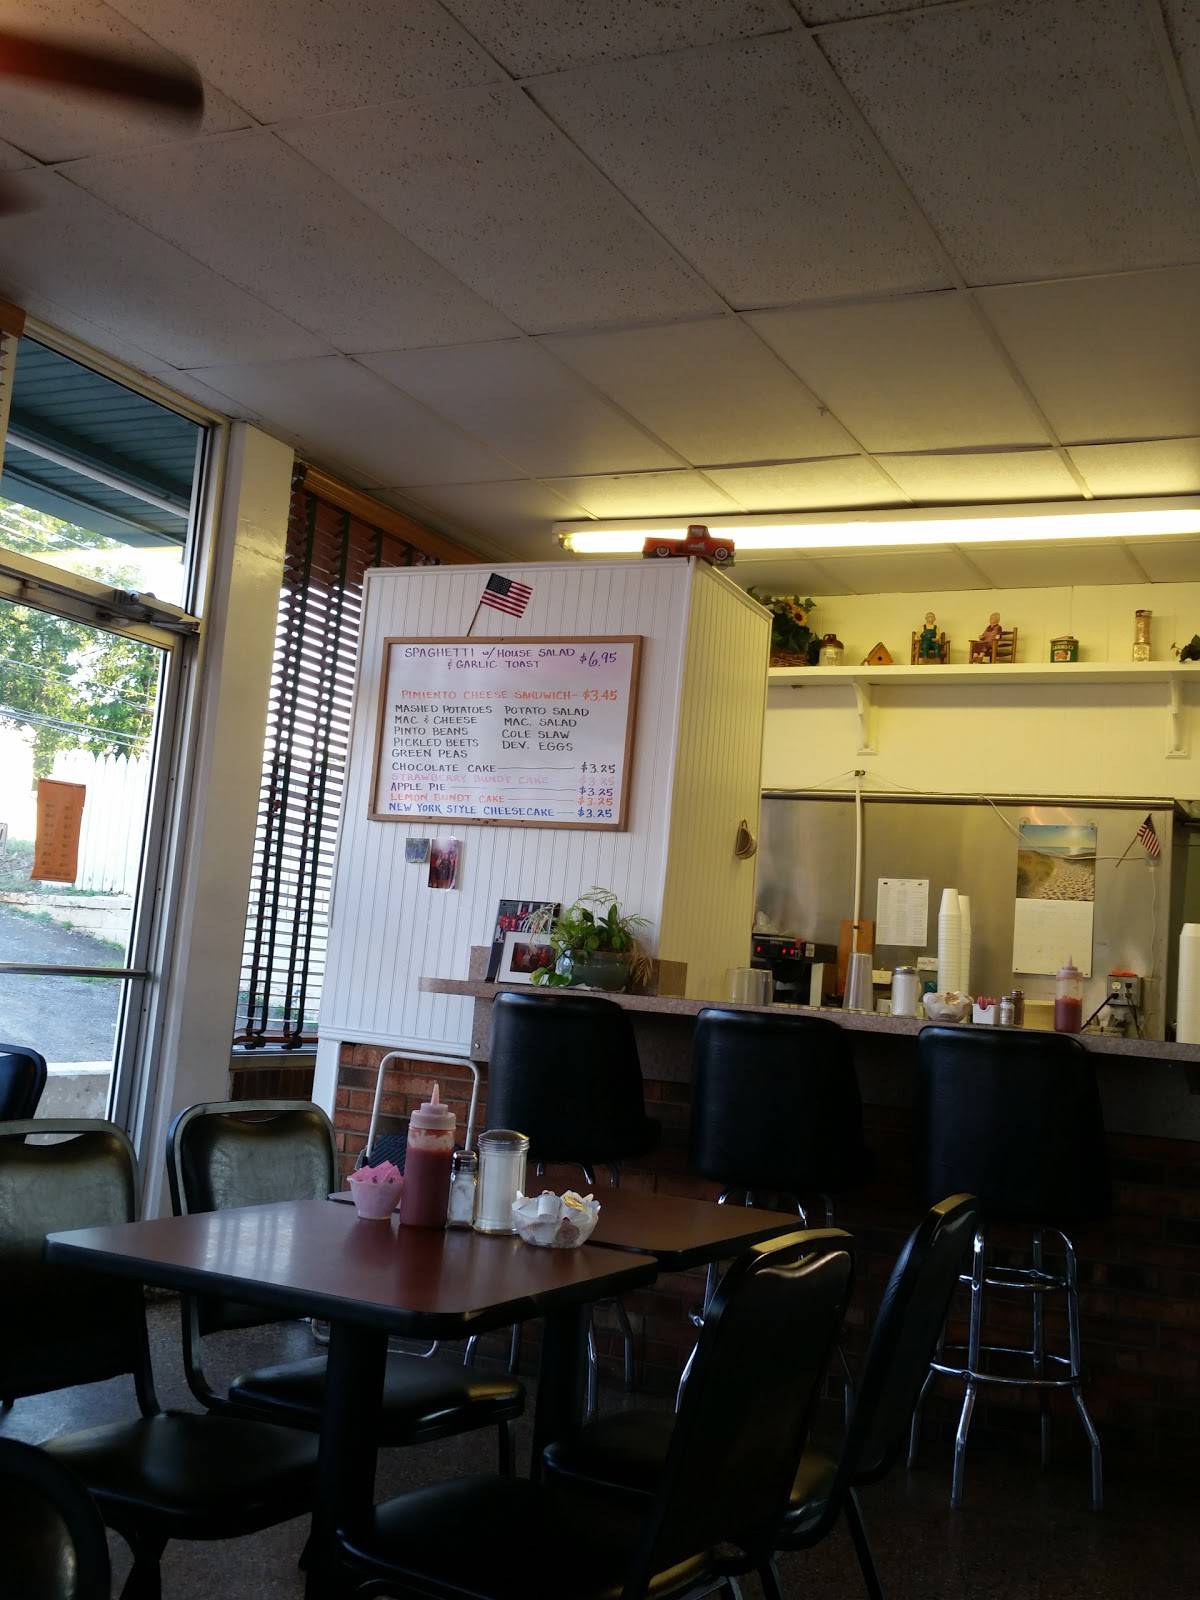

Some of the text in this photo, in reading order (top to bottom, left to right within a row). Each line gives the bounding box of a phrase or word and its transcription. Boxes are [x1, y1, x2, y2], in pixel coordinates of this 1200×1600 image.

[405, 647, 475, 658] SPAGHETTI
[497, 649, 533, 658] HOUSE
[538, 648, 576, 657] SALAD
[579, 651, 617, 667] $6.95
[456, 660, 497, 669] GARLIC
[505, 660, 540, 669] TOAST
[463, 690, 507, 699] CHEESE
[582, 688, 617, 701] $3.45
[395, 704, 493, 714] MASHED POTATOES
[504, 705, 590, 717] POTATO SALAD
[394, 715, 418, 725] MAC
[433, 715, 478, 724] CHEESE
[539, 718, 577, 727] SALAD
[394, 726, 469, 736] PINTO BEANS
[502, 729, 570, 739] COLE SLAW
[393, 737, 479, 747] PICKLED BEETS
[502, 740, 574, 752] DEV. EGGS
[391, 748, 468, 758] GREEN PEAS
[391, 761, 616, 774] CHOCOLATE CAKE $3.25
[519, 776, 550, 784] CAKE
[390, 782, 614, 797] APPLE PIE $3.25
[390, 792, 428, 801] LEMON
[433, 793, 472, 801] BUNDT
[479, 794, 505, 803] CAKE
[388, 802, 613, 818] NEW YORK STYLE CHEESECAKE $3.25
